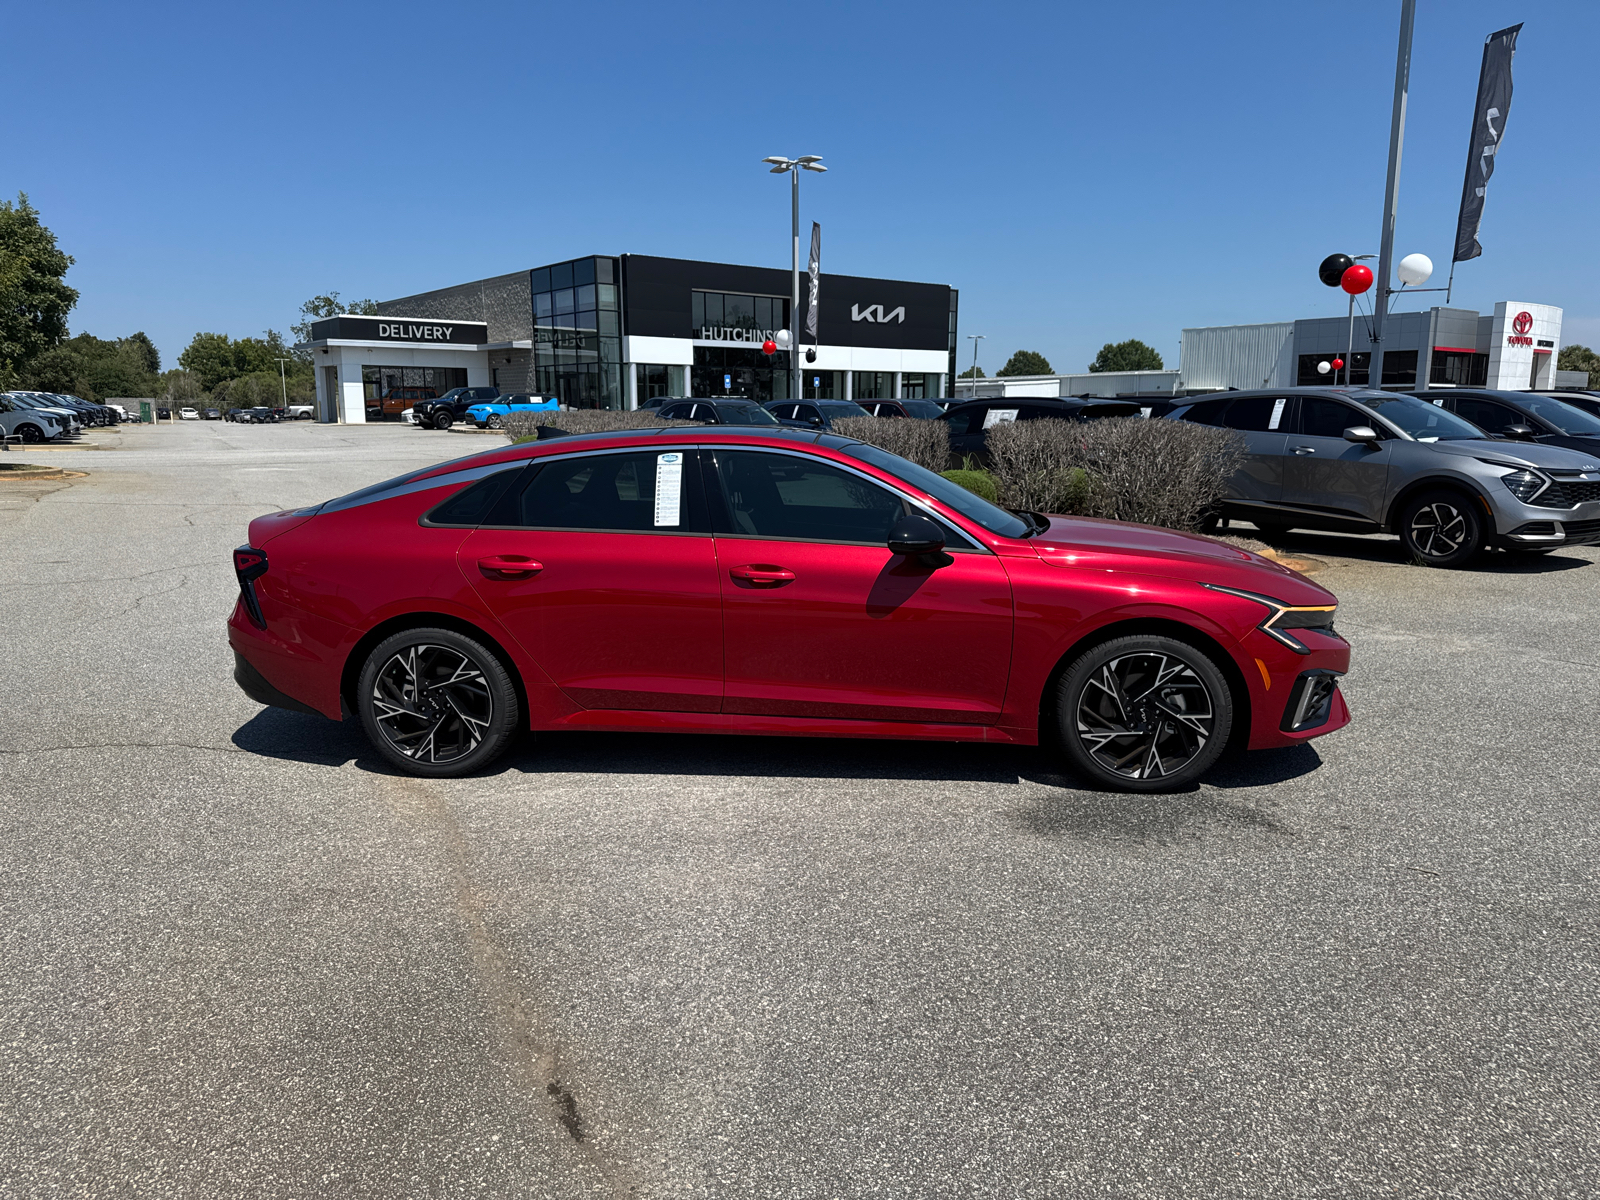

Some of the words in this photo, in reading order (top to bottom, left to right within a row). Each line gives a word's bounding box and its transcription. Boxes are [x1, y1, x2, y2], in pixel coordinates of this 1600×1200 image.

[851, 303, 905, 324] KIA
[379, 323, 453, 340] DELIVERY
[1507, 335, 1533, 346] TOYOTA
